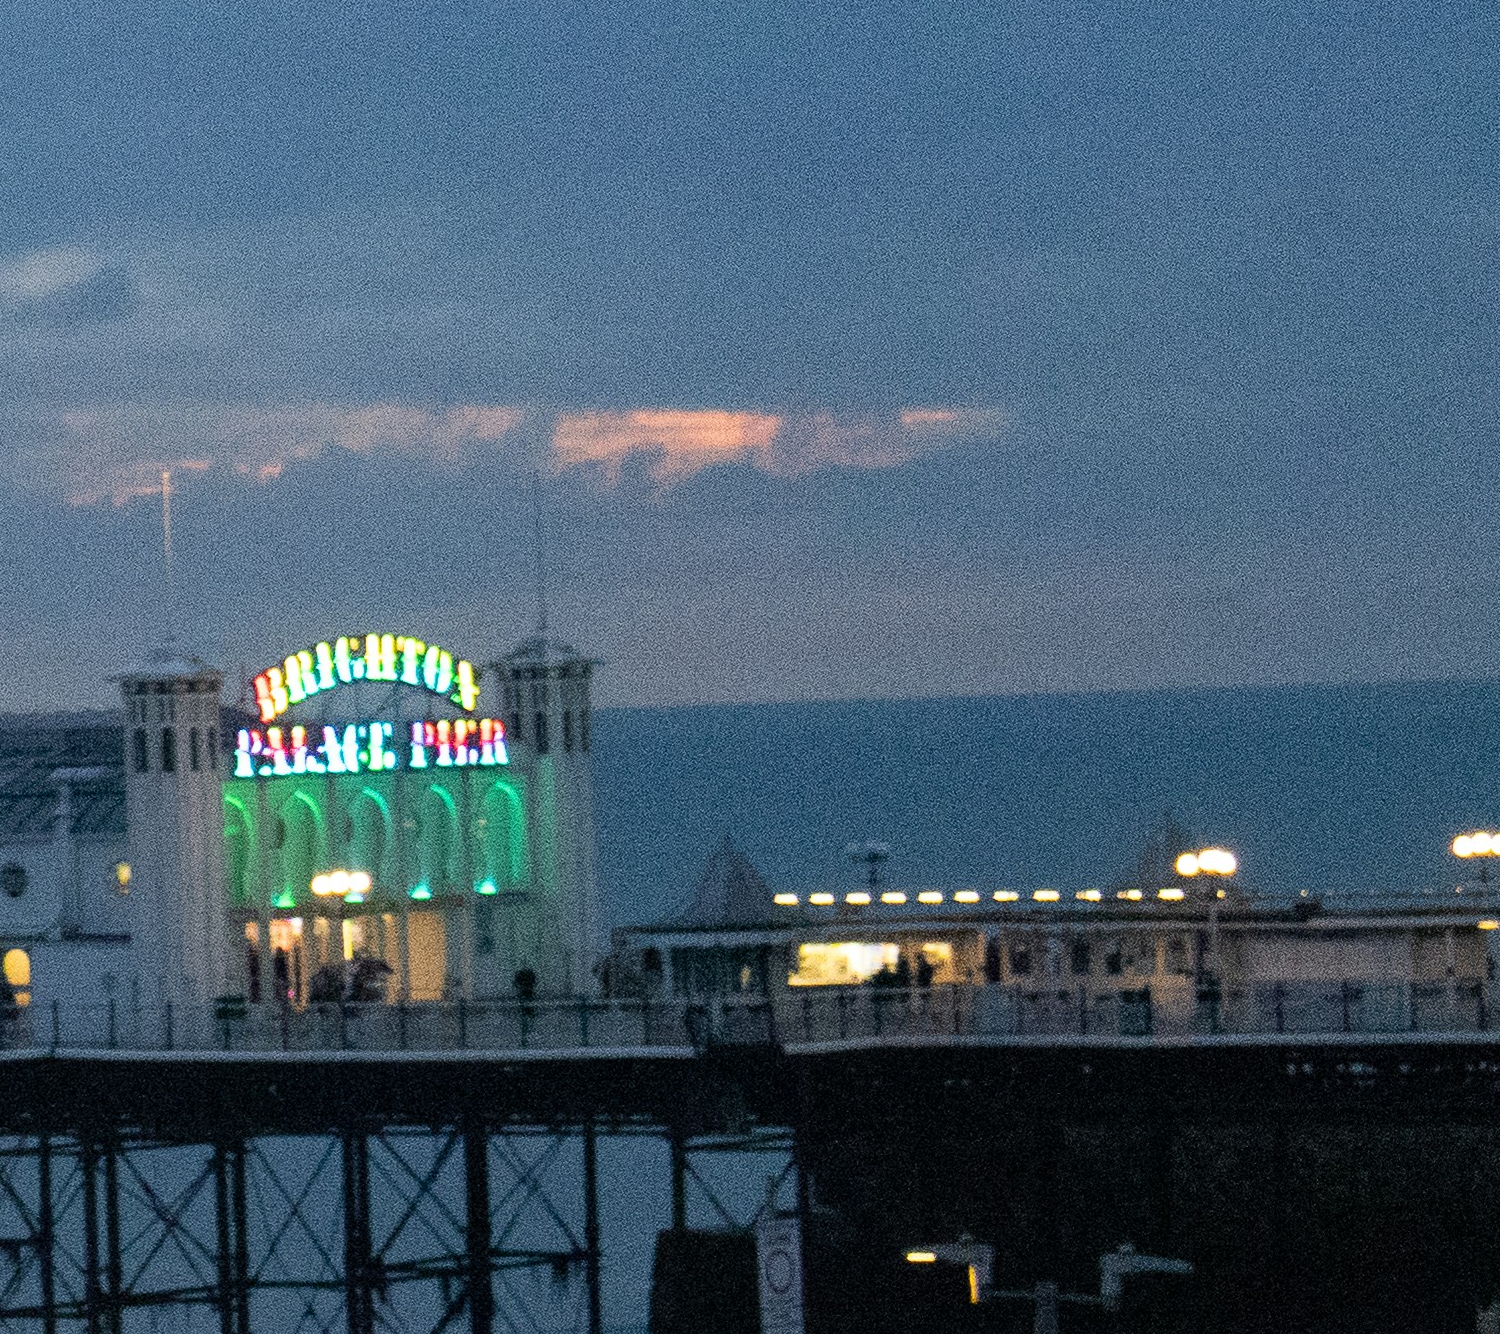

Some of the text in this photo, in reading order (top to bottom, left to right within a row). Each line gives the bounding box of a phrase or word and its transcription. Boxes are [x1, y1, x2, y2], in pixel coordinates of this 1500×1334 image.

[252, 632, 480, 722] BRIGHTON
[233, 717, 510, 778] PALACE PIER
